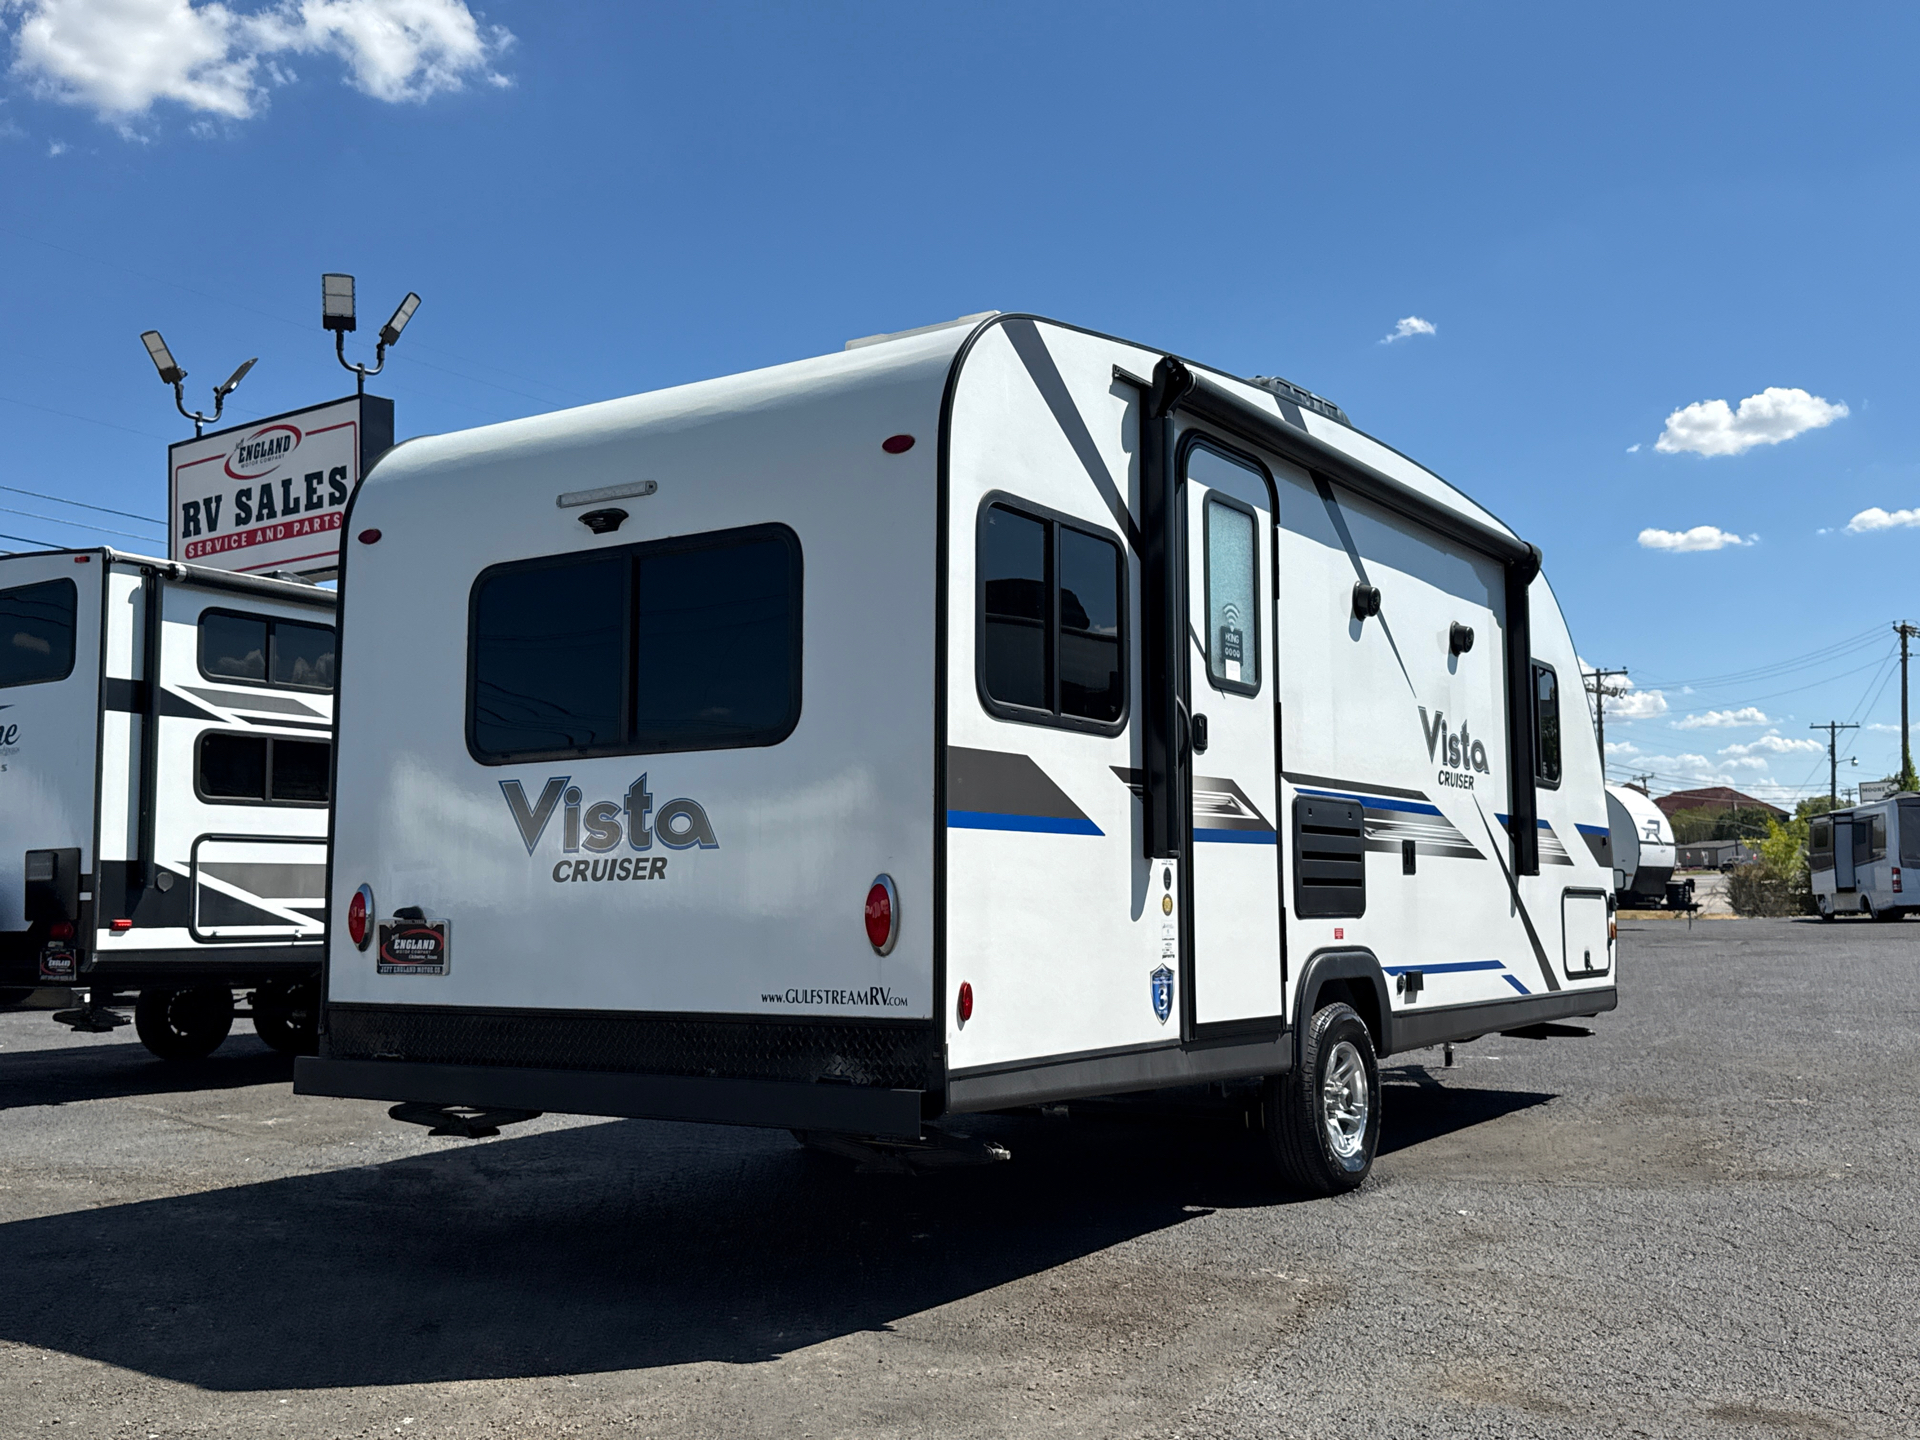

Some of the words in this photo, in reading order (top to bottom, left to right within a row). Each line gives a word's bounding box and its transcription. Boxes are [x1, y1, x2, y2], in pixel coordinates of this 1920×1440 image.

[238, 435, 291, 464] ENGLAND
[260, 453, 285, 464] COMPANY
[182, 494, 223, 539] RV
[235, 465, 348, 527] SALES
[188, 533, 247, 558] SERVICE
[256, 528, 285, 544] AND
[293, 514, 341, 536] PARTS
[1417, 705, 1490, 775] Vista
[1438, 769, 1475, 790] CRUISER
[498, 771, 720, 857] Vista
[552, 857, 668, 883] CRUISER
[394, 939, 436, 950] ENGLAND
[1158, 984, 1168, 1010] 3
